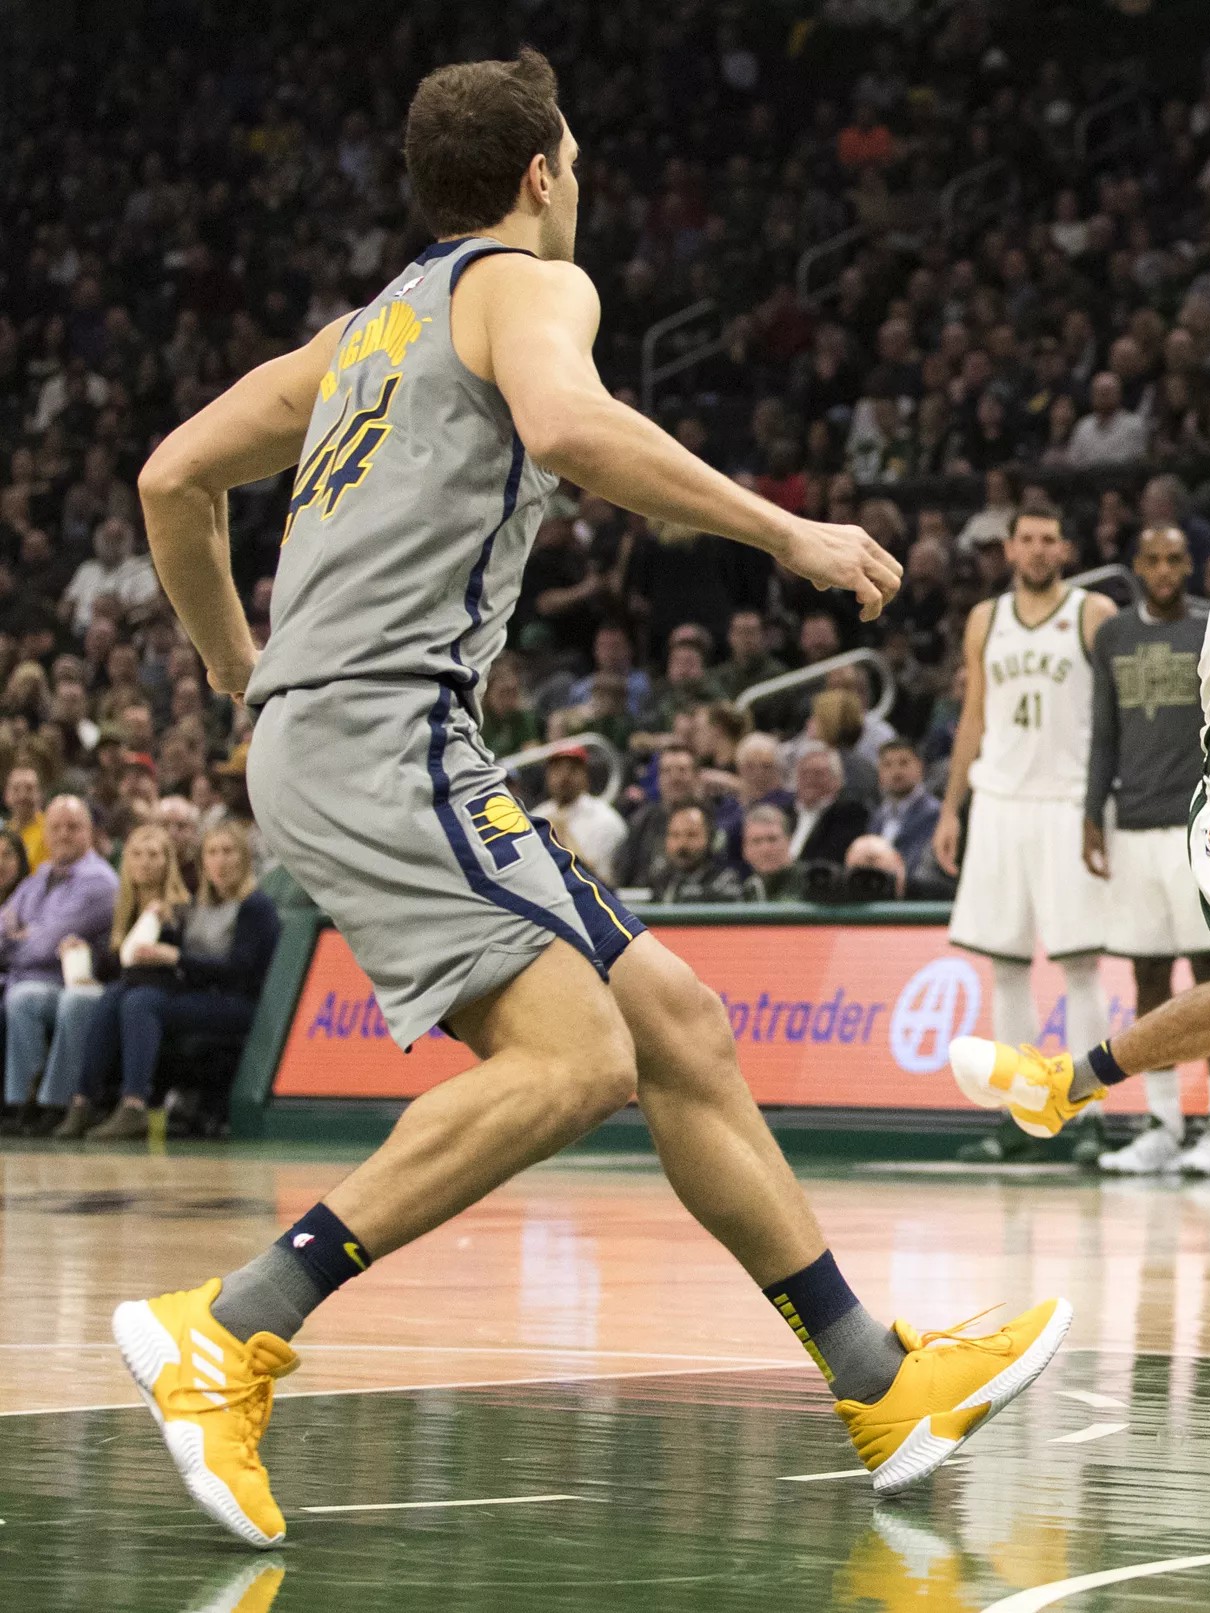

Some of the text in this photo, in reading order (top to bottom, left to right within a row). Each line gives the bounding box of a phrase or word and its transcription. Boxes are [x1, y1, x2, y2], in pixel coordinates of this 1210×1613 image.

[281, 372, 402, 545] 44
[992, 650, 1073, 685] BUCKS
[1014, 692, 1042, 729] 41
[721, 987, 886, 1042] otrader
